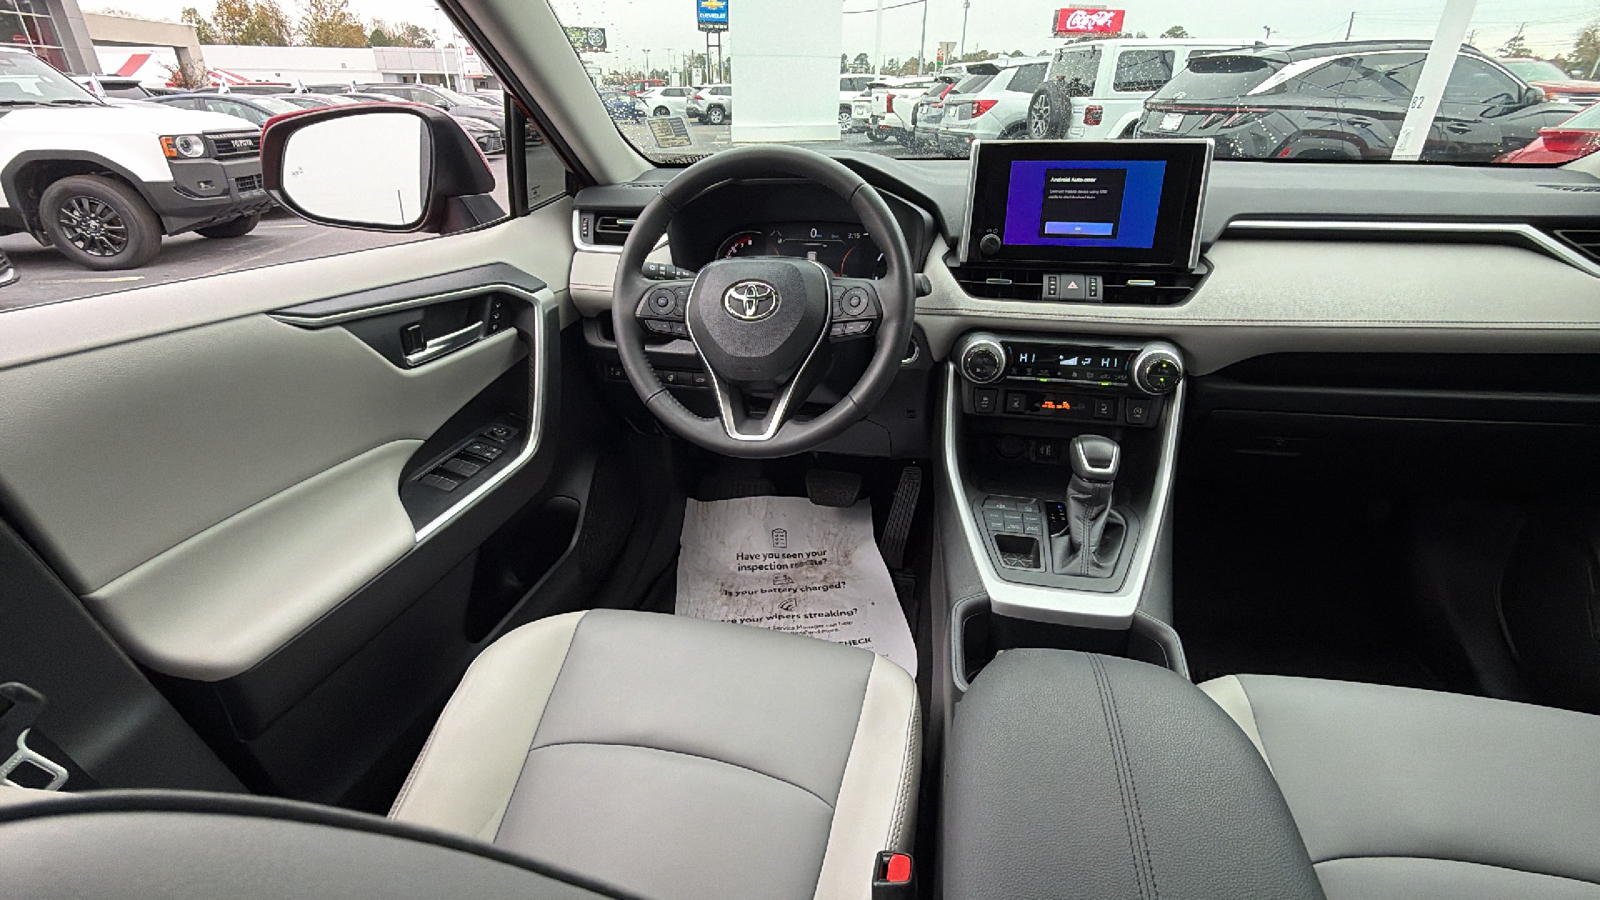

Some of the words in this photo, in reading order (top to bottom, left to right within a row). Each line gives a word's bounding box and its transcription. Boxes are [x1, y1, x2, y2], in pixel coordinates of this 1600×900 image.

[231, 139, 254, 148] TOYOTA
[810, 228, 817, 238] 0
[736, 552, 760, 560] Have
[762, 553, 780, 561] you
[804, 550, 827, 559] your
[738, 562, 788, 572] inspection
[800, 582, 846, 592] charged?
[804, 608, 858, 619] streaking?
